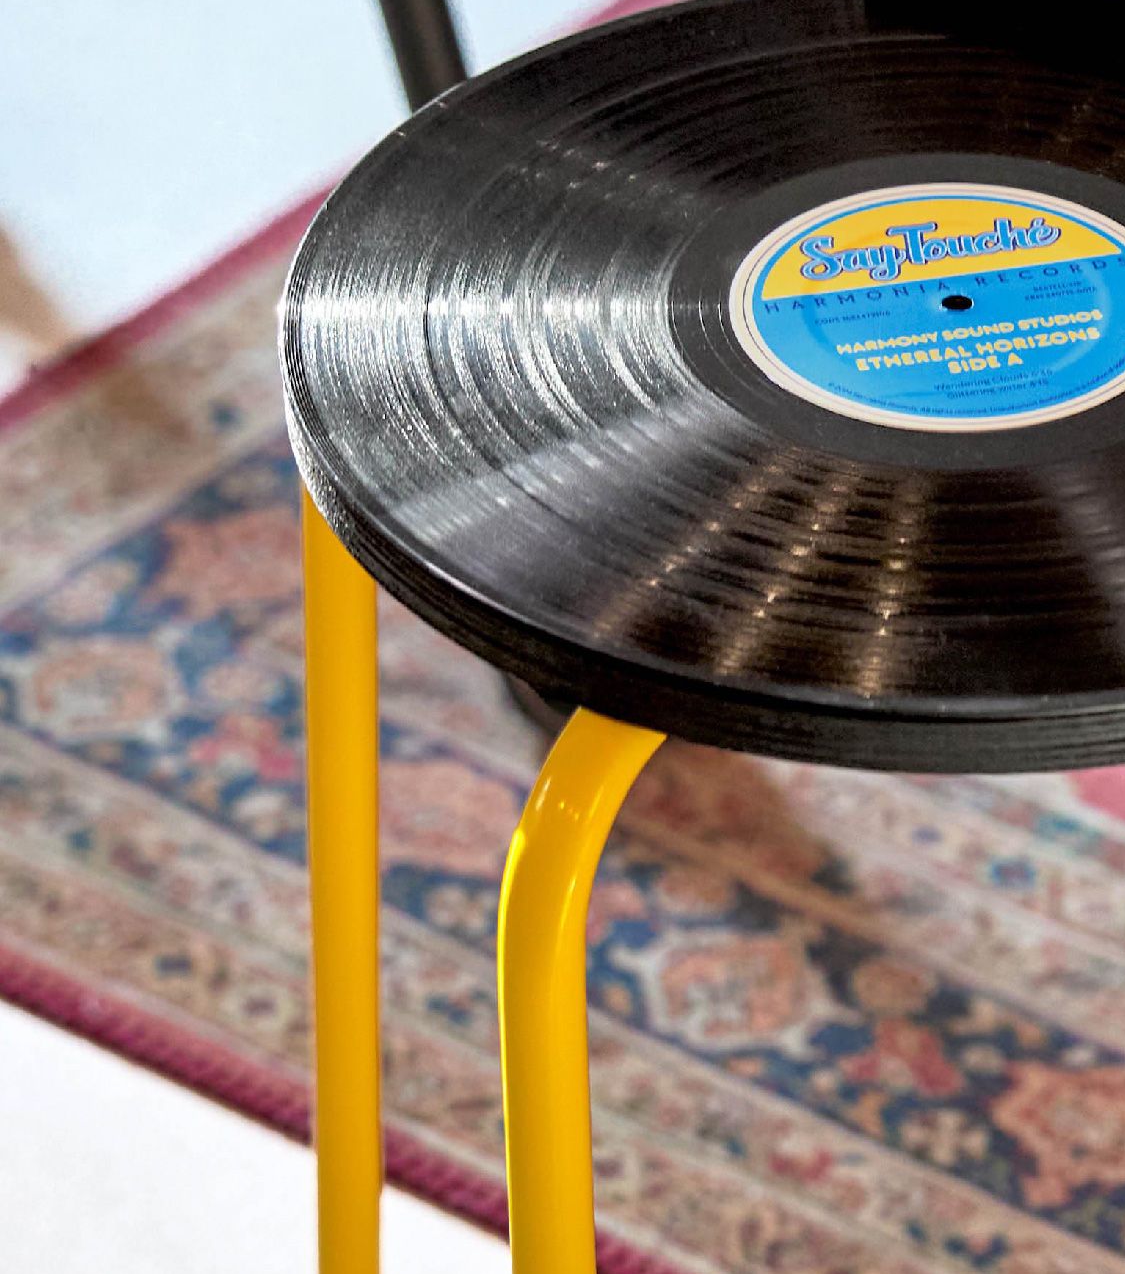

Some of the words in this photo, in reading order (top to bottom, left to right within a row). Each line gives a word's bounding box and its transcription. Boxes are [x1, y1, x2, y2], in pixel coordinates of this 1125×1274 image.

[800, 217, 1062, 282] SayTouché
[764, 279, 951, 315] HARMONIA
[836, 331, 938, 355] HARMONY
[941, 323, 1015, 343] SOUND
[1017, 309, 1104, 331] STUDIOS
[855, 344, 972, 372] ETHEREAL
[975, 326, 1102, 357] HORIZONS
[947, 355, 1001, 375] SIDE
[1006, 351, 1024, 367] A
